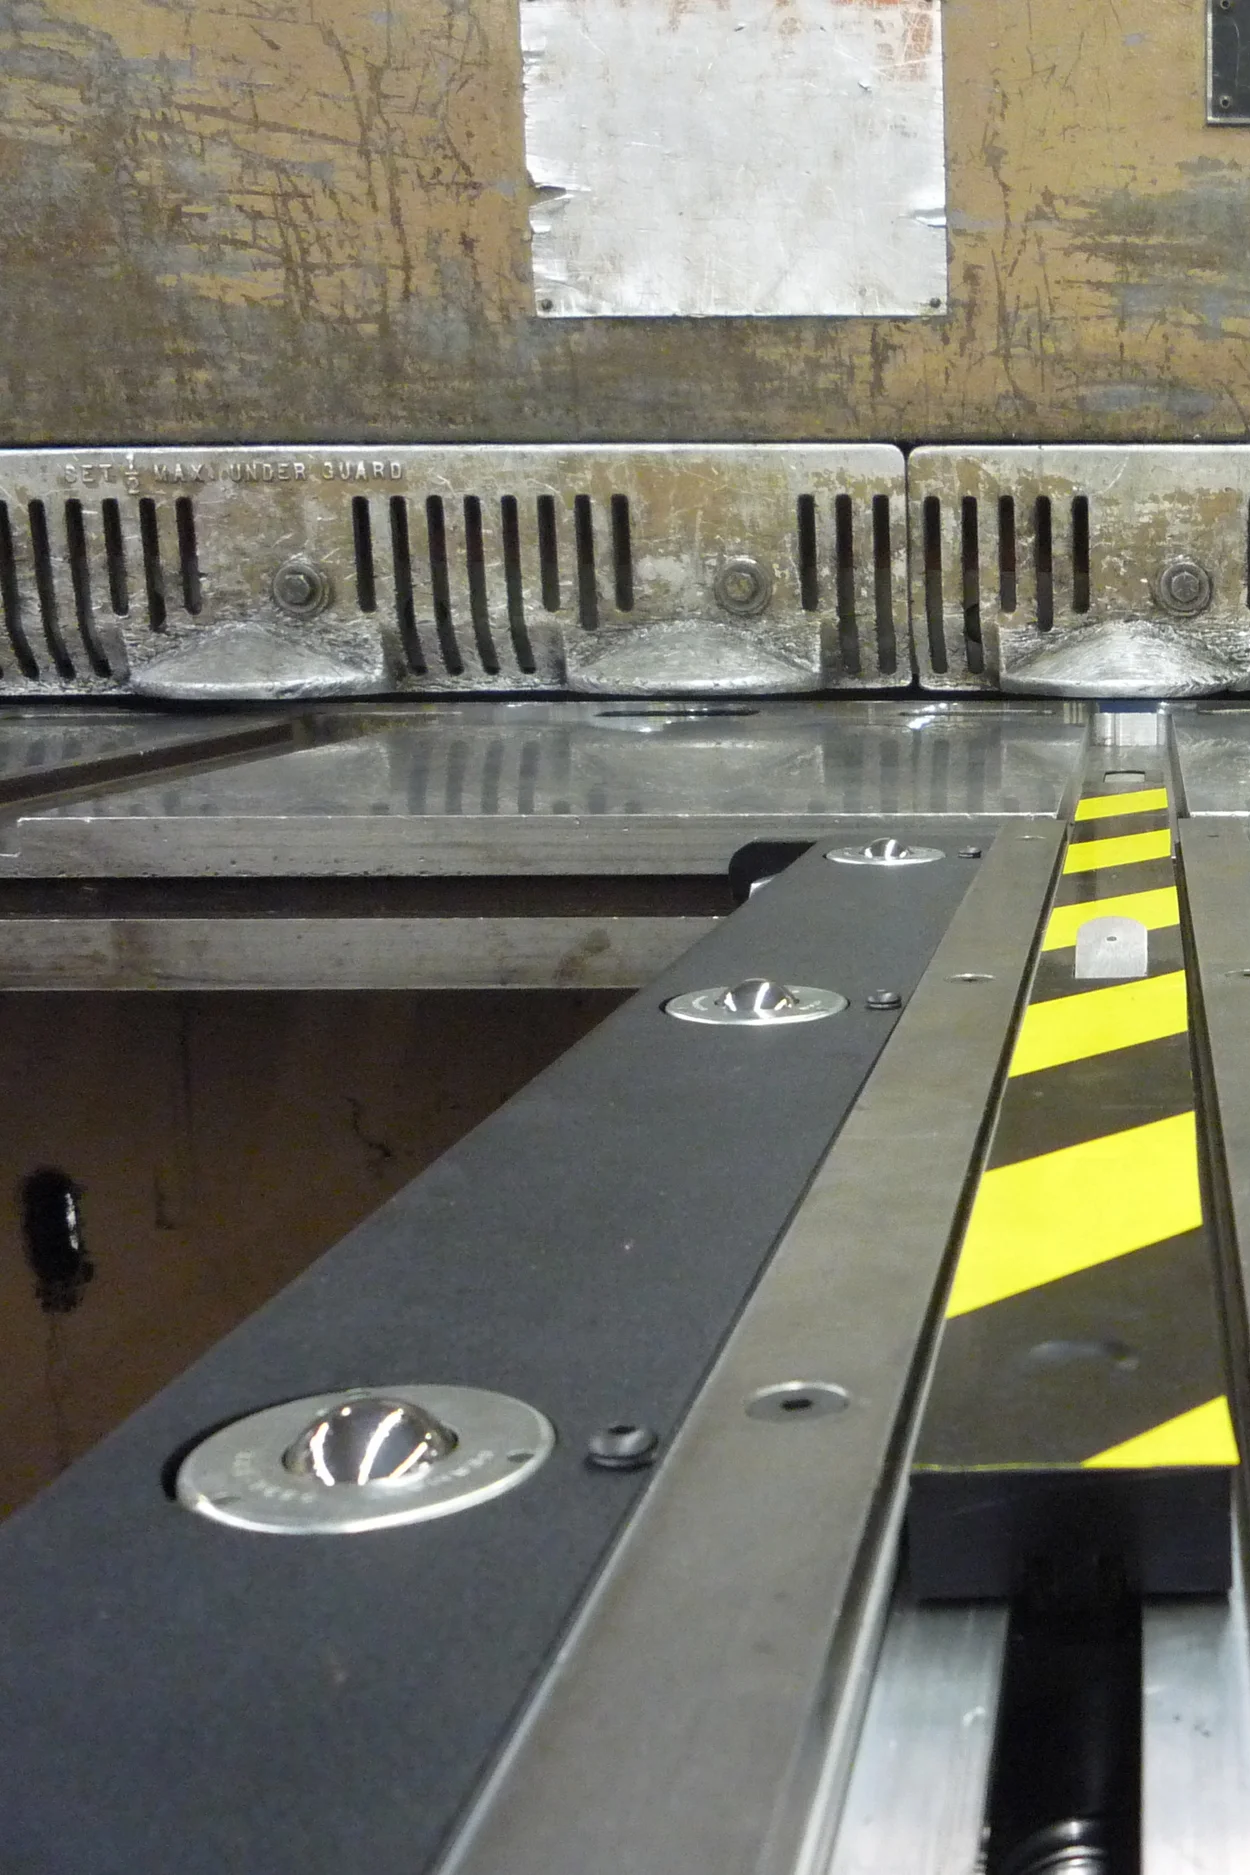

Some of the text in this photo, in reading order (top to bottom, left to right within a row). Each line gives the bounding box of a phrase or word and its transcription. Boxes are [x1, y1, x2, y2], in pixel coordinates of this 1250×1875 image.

[64, 463, 113, 484] SET
[229, 462, 307, 483] UNDER
[323, 460, 403, 481] GUARD
